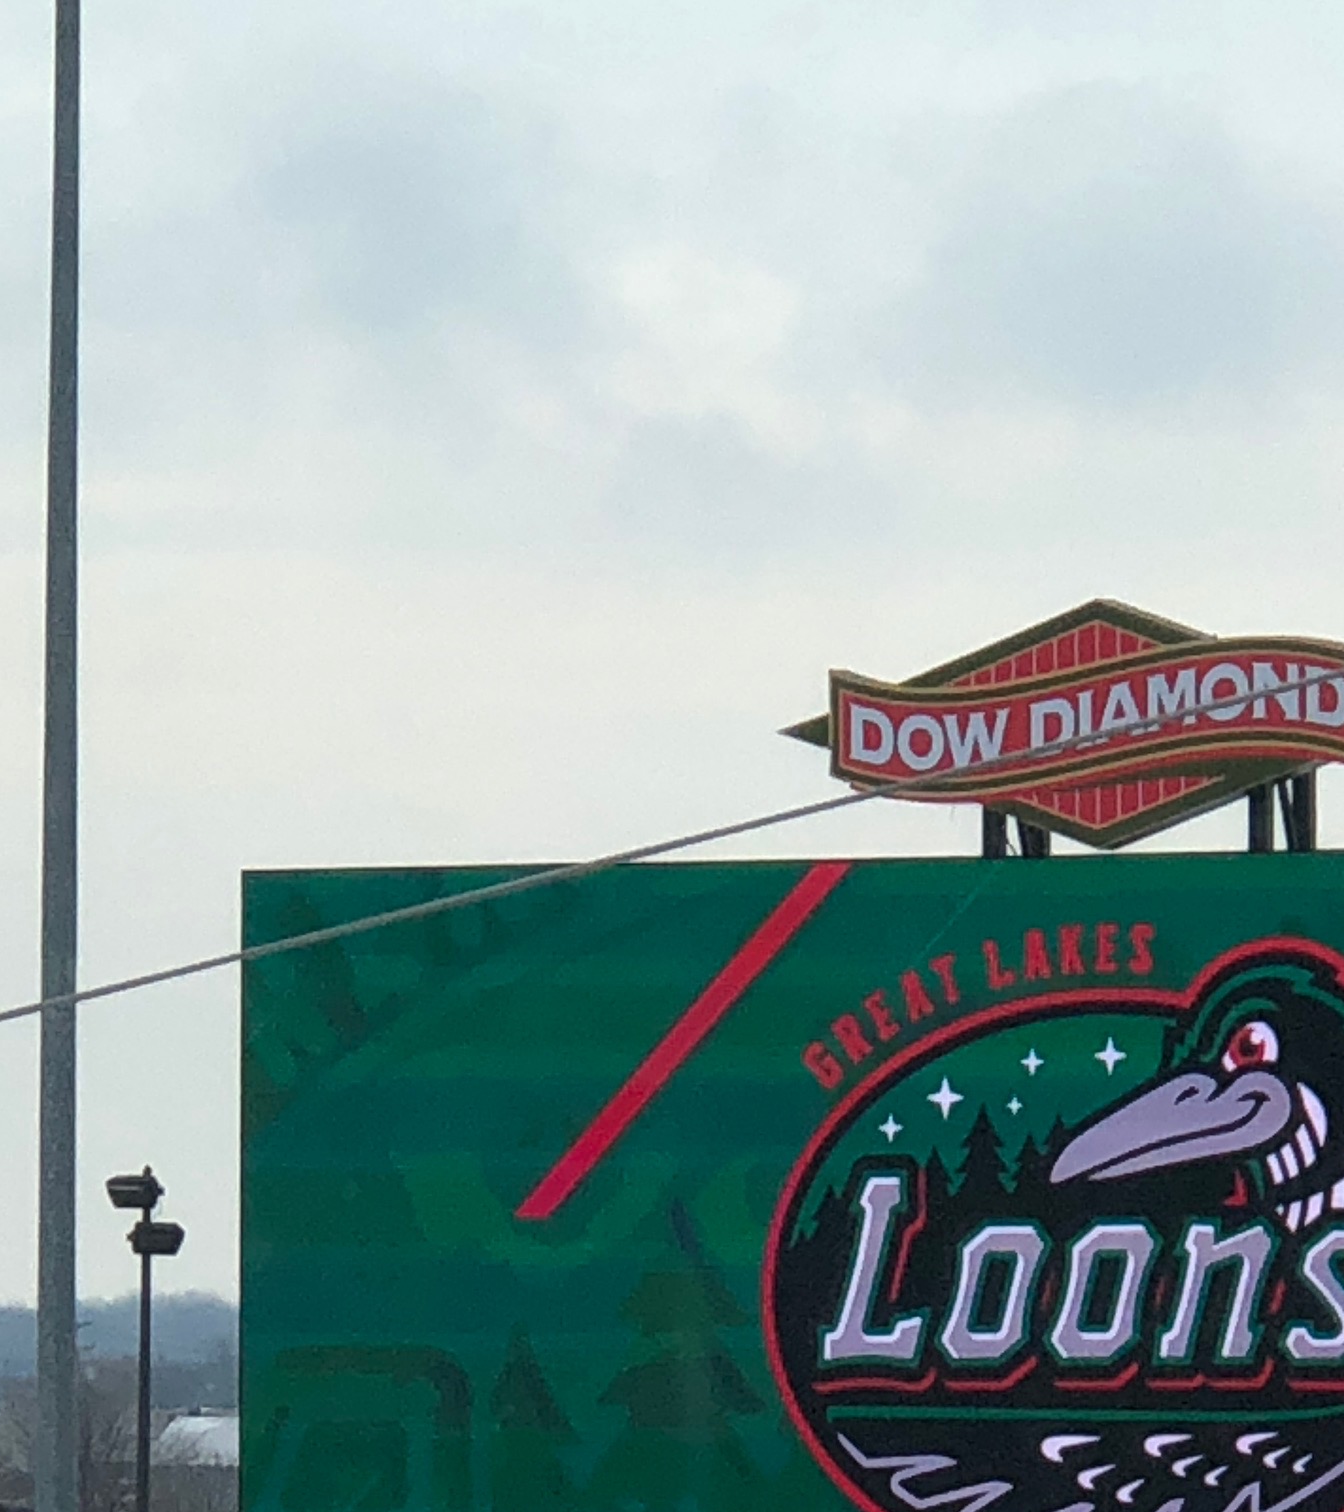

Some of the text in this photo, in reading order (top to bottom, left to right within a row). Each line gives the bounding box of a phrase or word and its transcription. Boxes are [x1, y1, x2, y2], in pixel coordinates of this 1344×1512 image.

[850, 702, 1011, 771] DOW
[801, 922, 1156, 1090] GREAT LAKES
